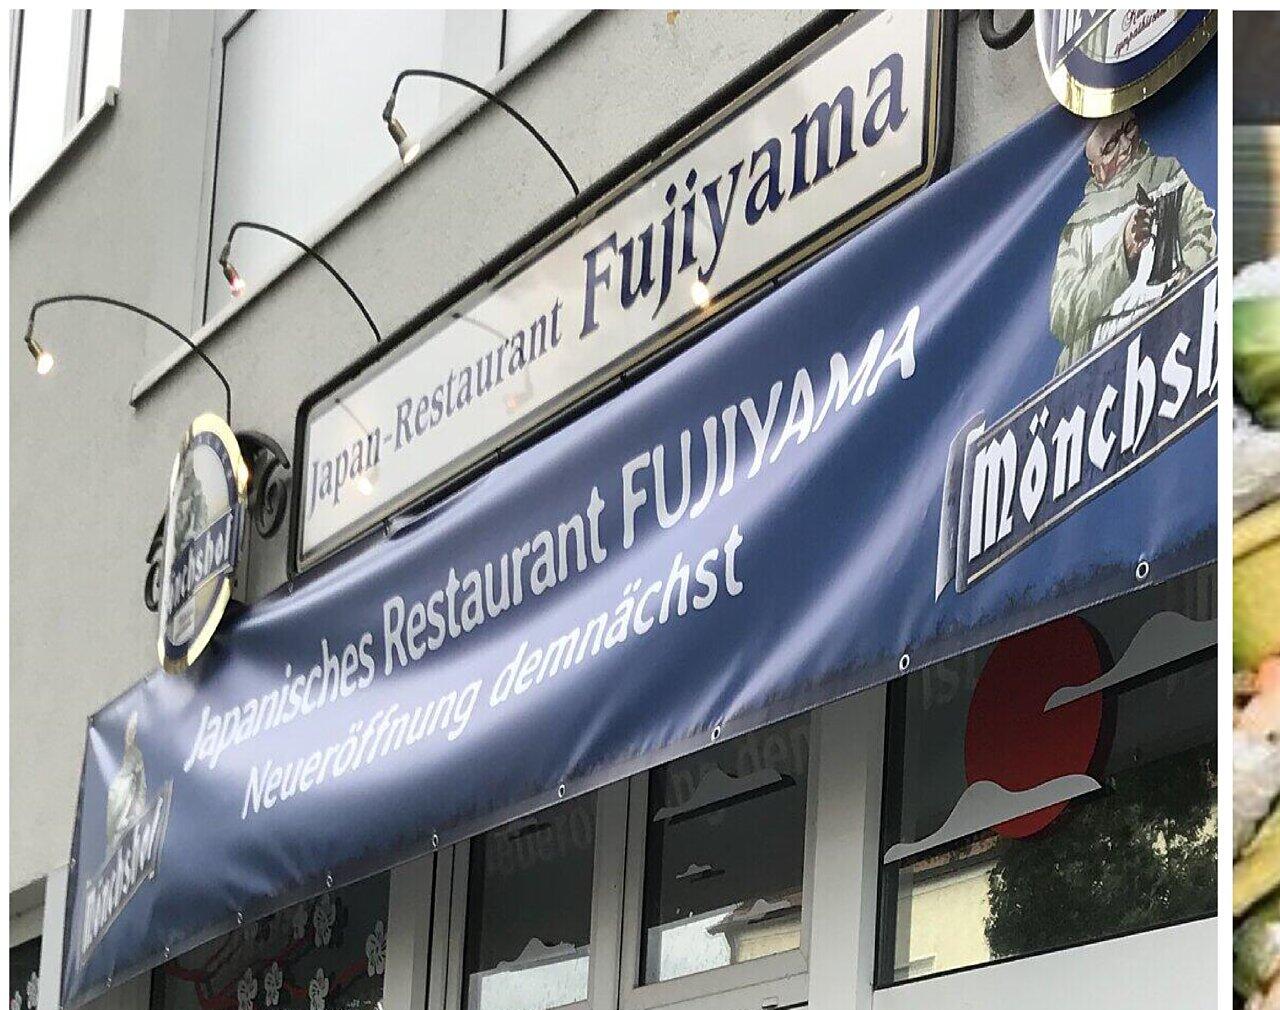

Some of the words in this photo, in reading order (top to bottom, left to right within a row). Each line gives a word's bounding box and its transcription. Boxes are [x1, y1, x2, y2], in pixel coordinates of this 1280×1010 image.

[306, 296, 564, 519] Japan-Restaurant
[579, 51, 908, 340] Fujiyama
[182, 632, 375, 773] Japanisches
[383, 486, 607, 676] Restaurant
[622, 305, 920, 549] FUJIYAMA
[241, 679, 483, 820] Neueröffnung
[490, 523, 744, 707] demnächst
